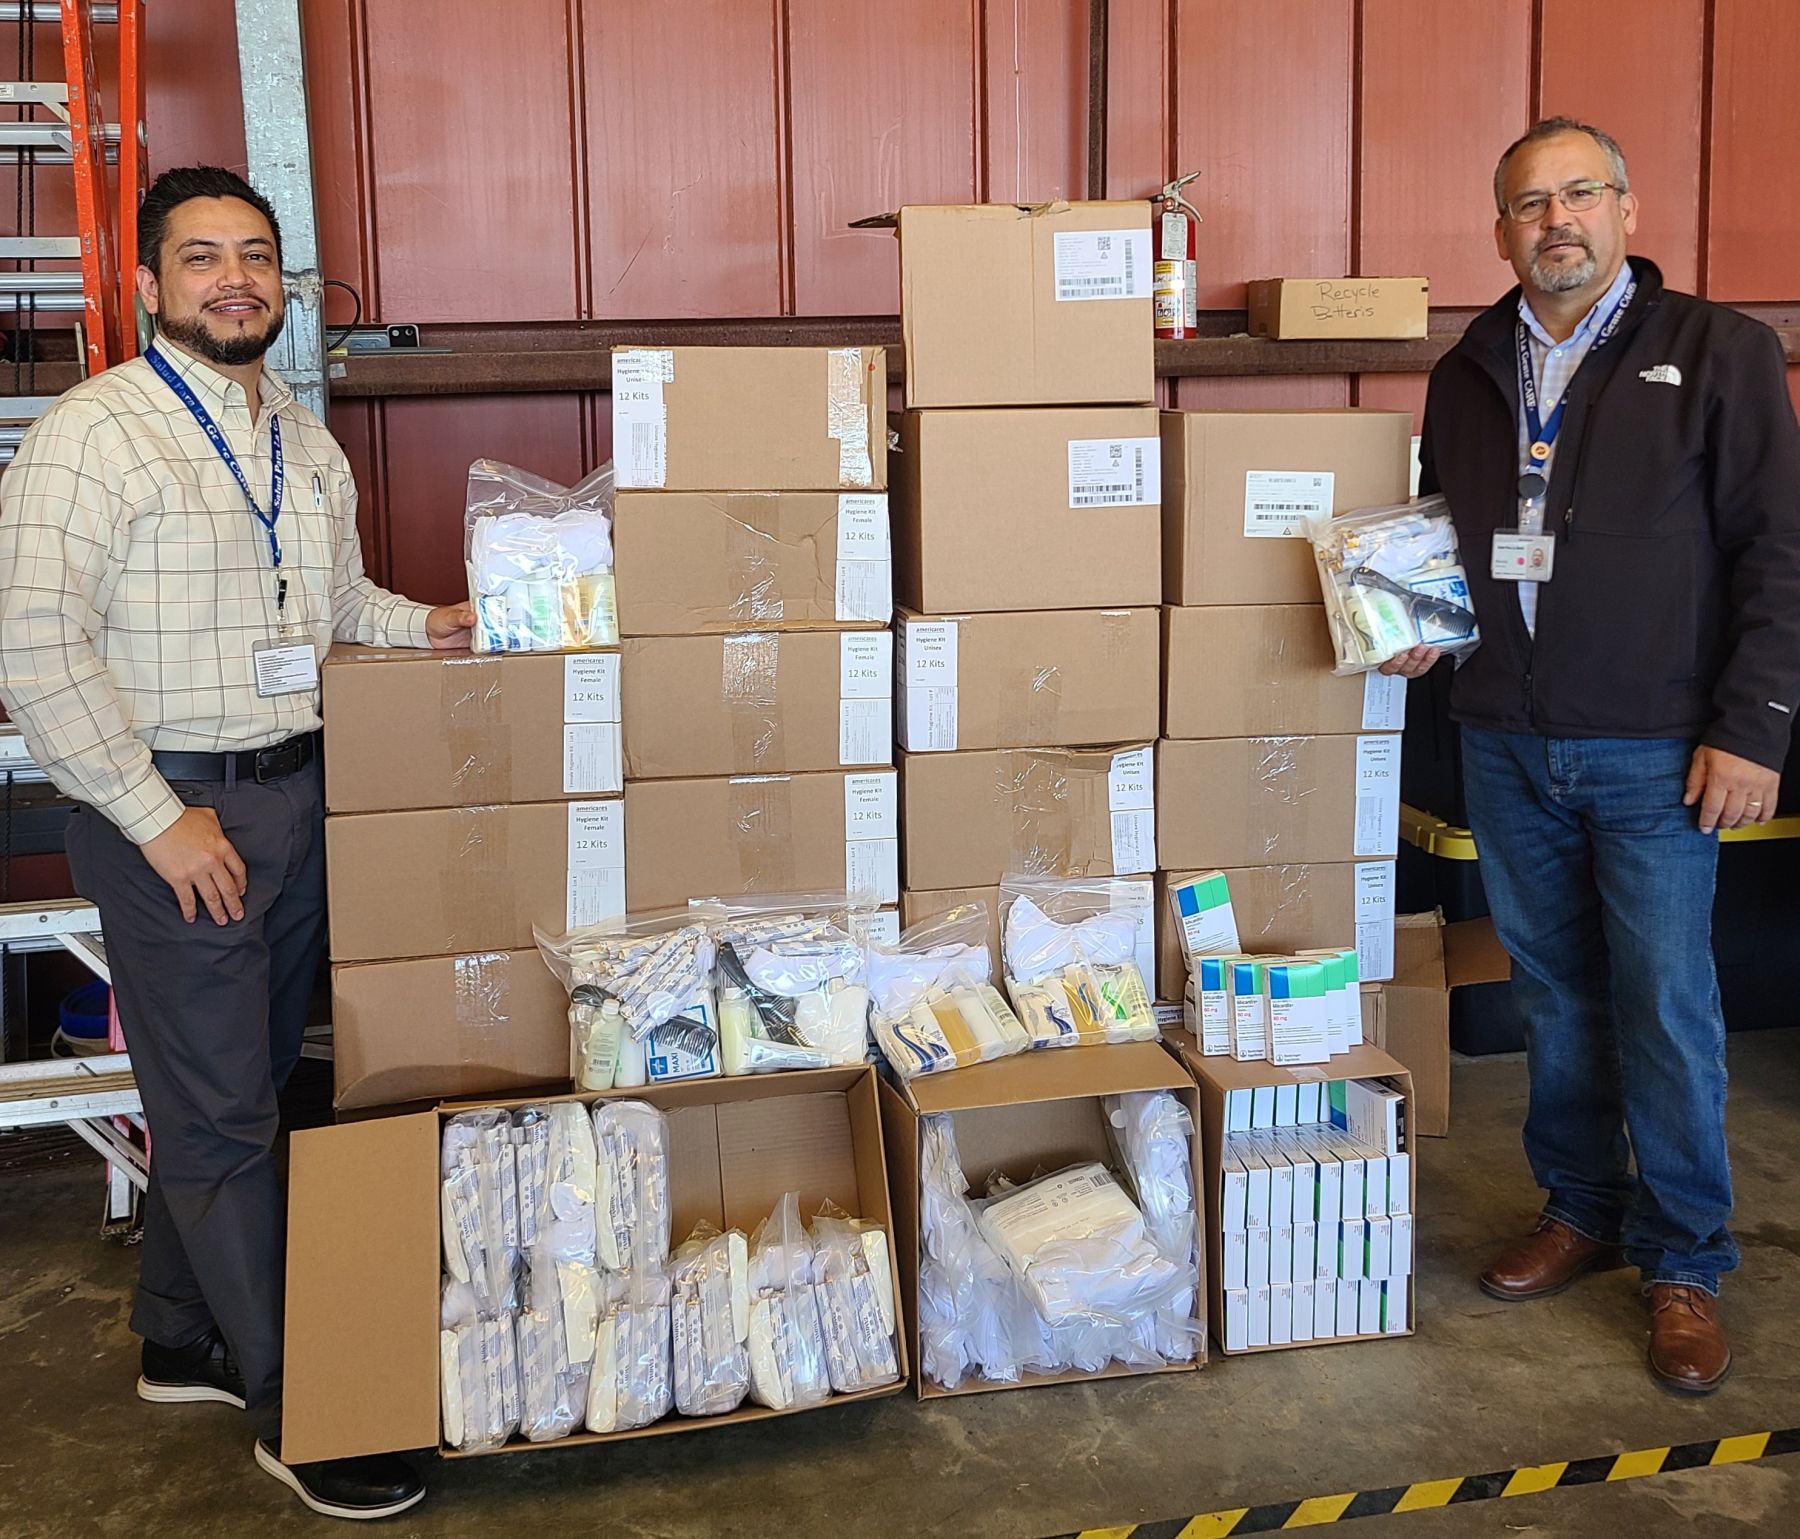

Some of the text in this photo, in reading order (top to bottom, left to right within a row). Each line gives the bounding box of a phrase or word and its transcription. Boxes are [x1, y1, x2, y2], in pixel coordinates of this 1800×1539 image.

[1316, 281, 1380, 303] Recycle
[1601, 308, 1624, 337] Gente
[1520, 352, 1530, 380] Gente
[150, 355, 173, 382] Salud
[173, 380, 195, 407] Para
[619, 392, 650, 401] 12 Kits
[1524, 381, 1536, 408] CARE
[274, 449, 283, 475] Para
[273, 474, 282, 509] Salud
[845, 531, 875, 541] 12 Kits
[916, 659, 945, 668] 12 Kits
[848, 669, 878, 678] 12 Kits
[572, 692, 604, 702] 12 Kits
[1363, 770, 1390, 778] 12 Kits
[1116, 783, 1144, 792] 12 Kits
[853, 811, 882, 821] 12 Kits
[576, 840, 608, 849] 12 Kits
[1362, 897, 1370, 905] 12
[863, 1317, 871, 1341] TAMPAX
